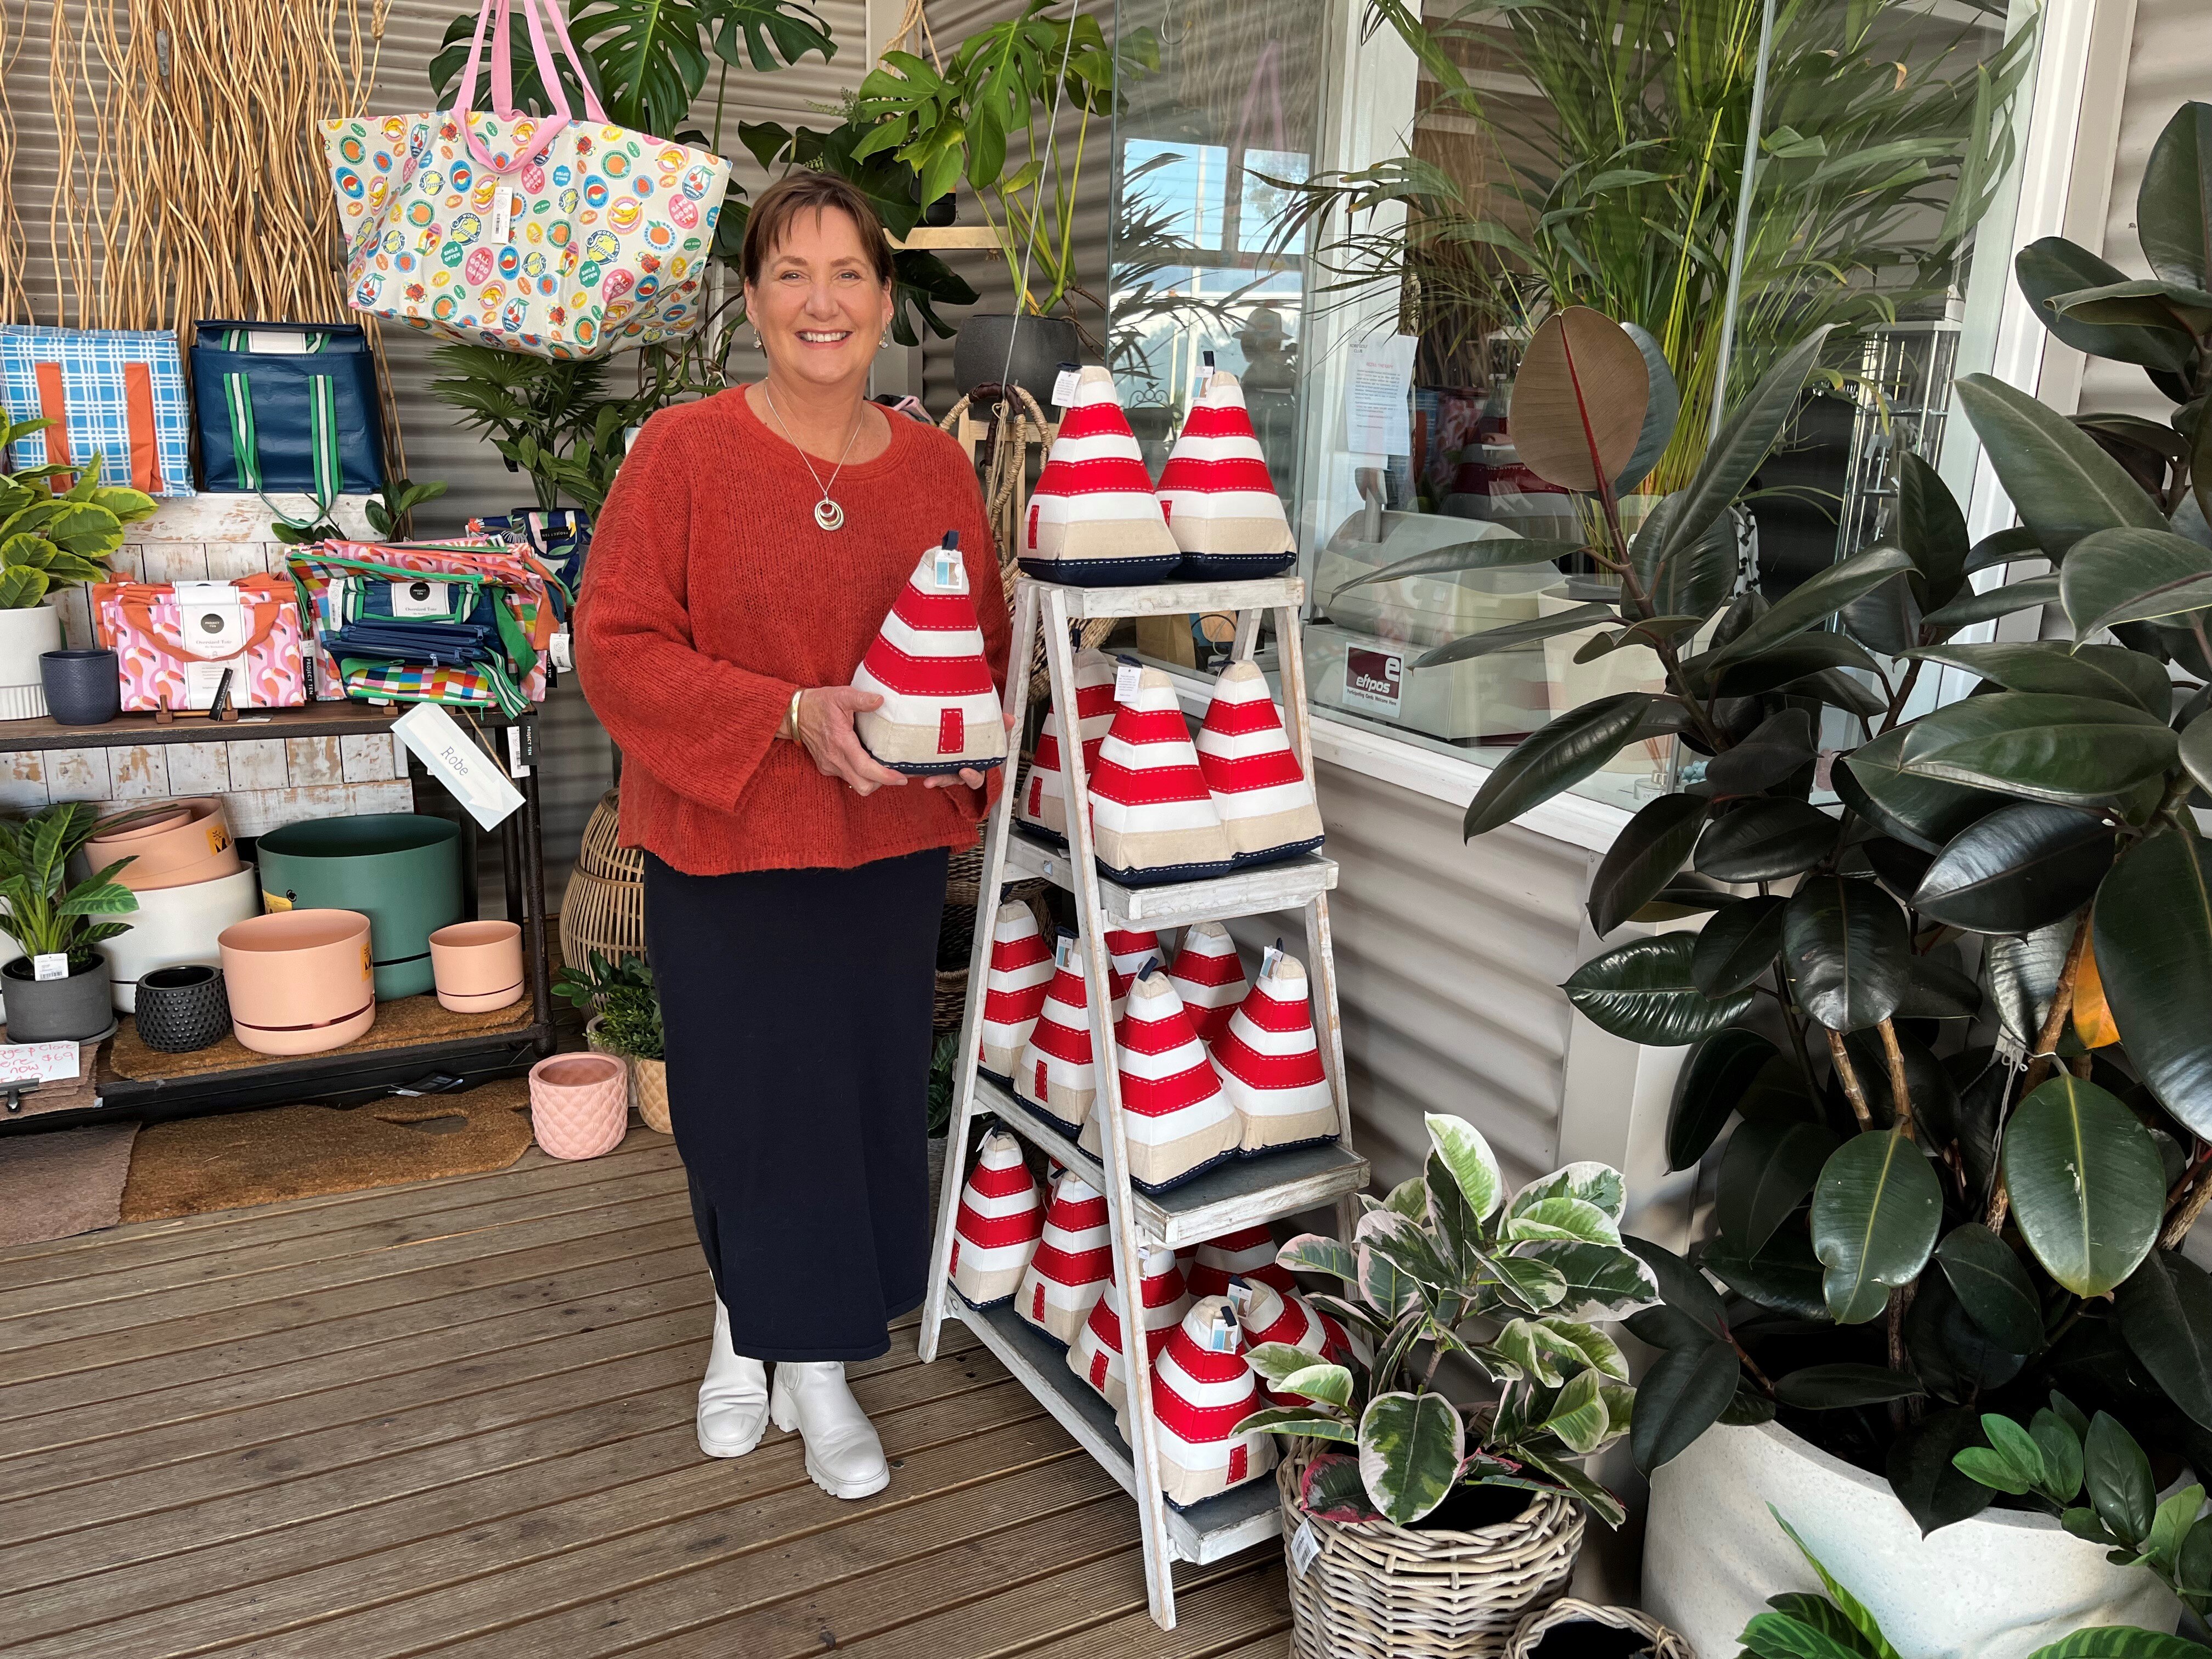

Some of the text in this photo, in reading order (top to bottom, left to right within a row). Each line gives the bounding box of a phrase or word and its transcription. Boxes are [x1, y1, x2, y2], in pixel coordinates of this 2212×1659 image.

[462, 213, 479, 222] WORTH
[597, 230, 616, 240] WORTH
[443, 246, 458, 256] SMILE
[444, 252, 460, 262] OFTEN
[477, 253, 489, 265] ALL
[470, 257, 489, 274] GOOD
[468, 266, 483, 281] DAYS
[581, 266, 595, 276] SMILE
[582, 272, 597, 282] OFTEN
[615, 274, 629, 287] ALL
[1356, 674, 1391, 693] eftpos
[1347, 689, 1364, 698] Participating
[1375, 696, 1388, 704] Welcome
[441, 746, 469, 776] Robe
[42, 1052, 74, 1062] $69
[10, 1064, 39, 1074] now
